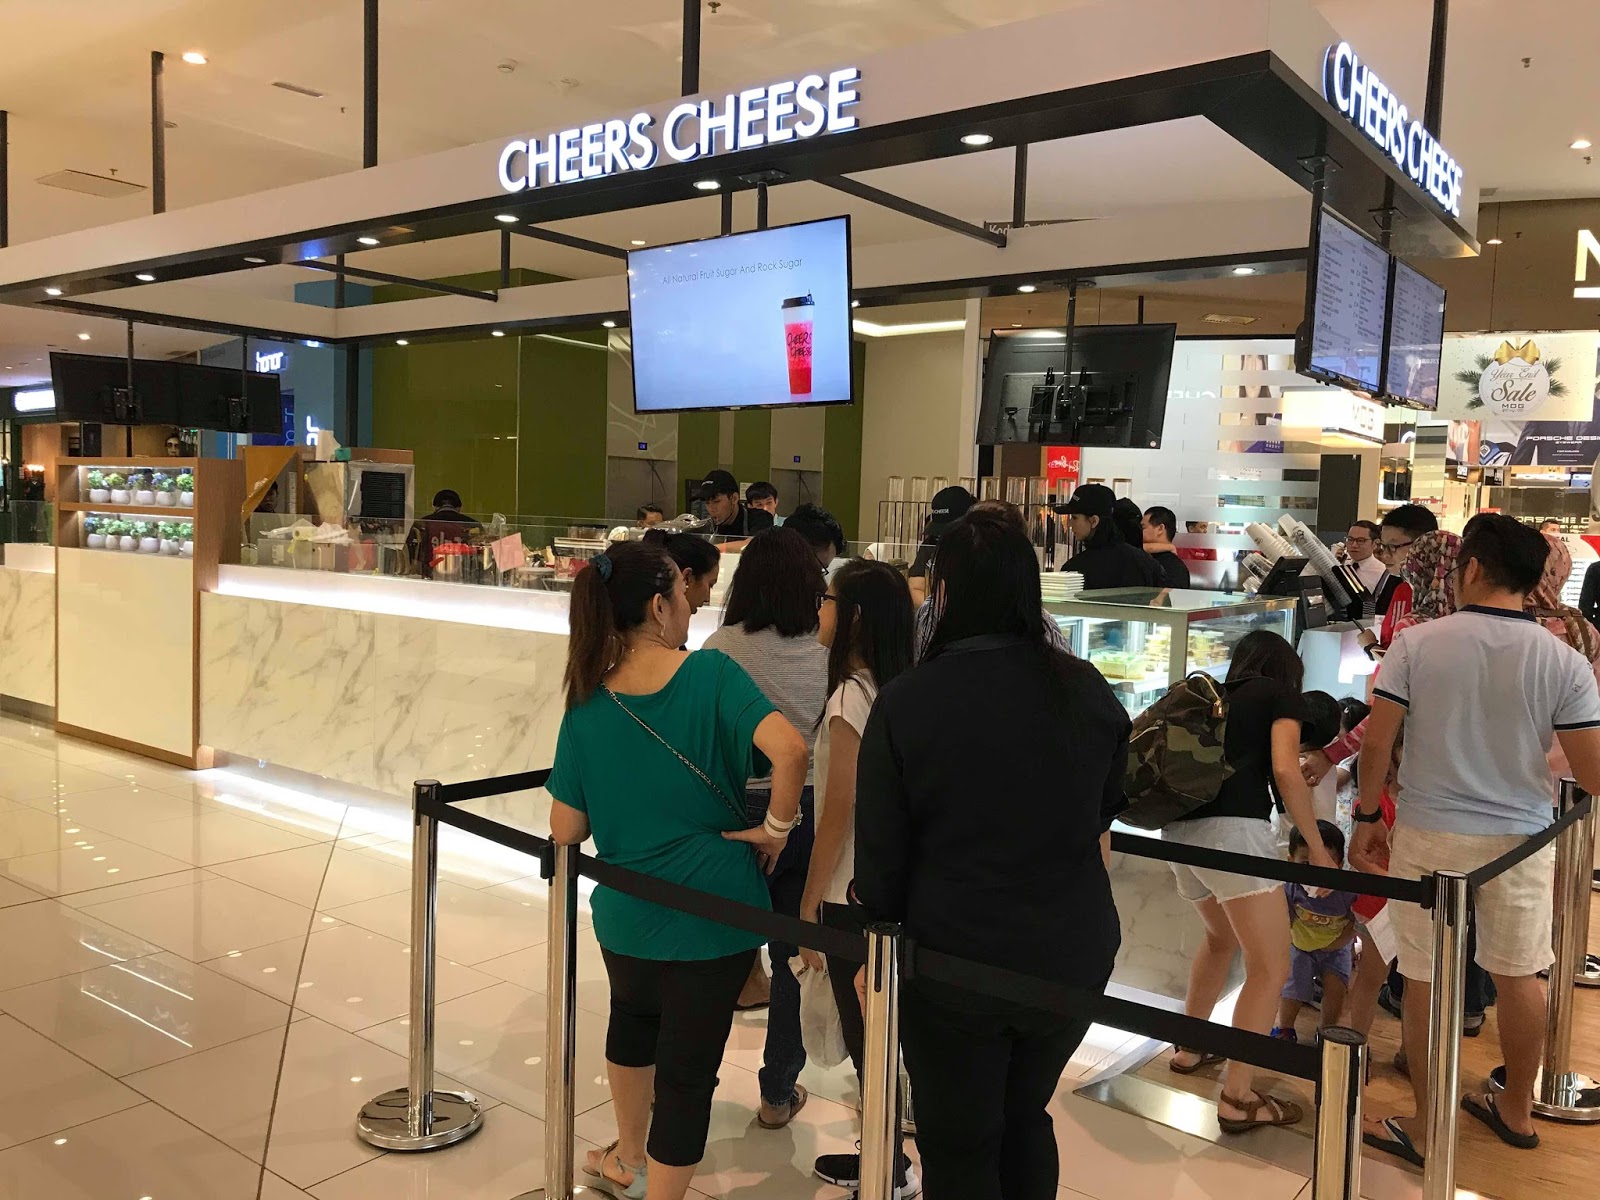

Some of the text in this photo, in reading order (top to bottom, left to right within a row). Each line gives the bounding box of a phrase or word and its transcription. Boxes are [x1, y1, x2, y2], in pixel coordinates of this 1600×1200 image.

[498, 67, 860, 193] CHEERS CHEESE
[1325, 41, 1463, 218] CHEERS CHEESE
[672, 271, 698, 284] Natural
[700, 270, 714, 280] Fruit
[716, 268, 737, 279] Sugar
[740, 264, 755, 275] And
[758, 261, 777, 272] Rock
[779, 258, 803, 270] Sugar
[1489, 367, 1541, 382] Year End
[1490, 379, 1537, 402] Sale
